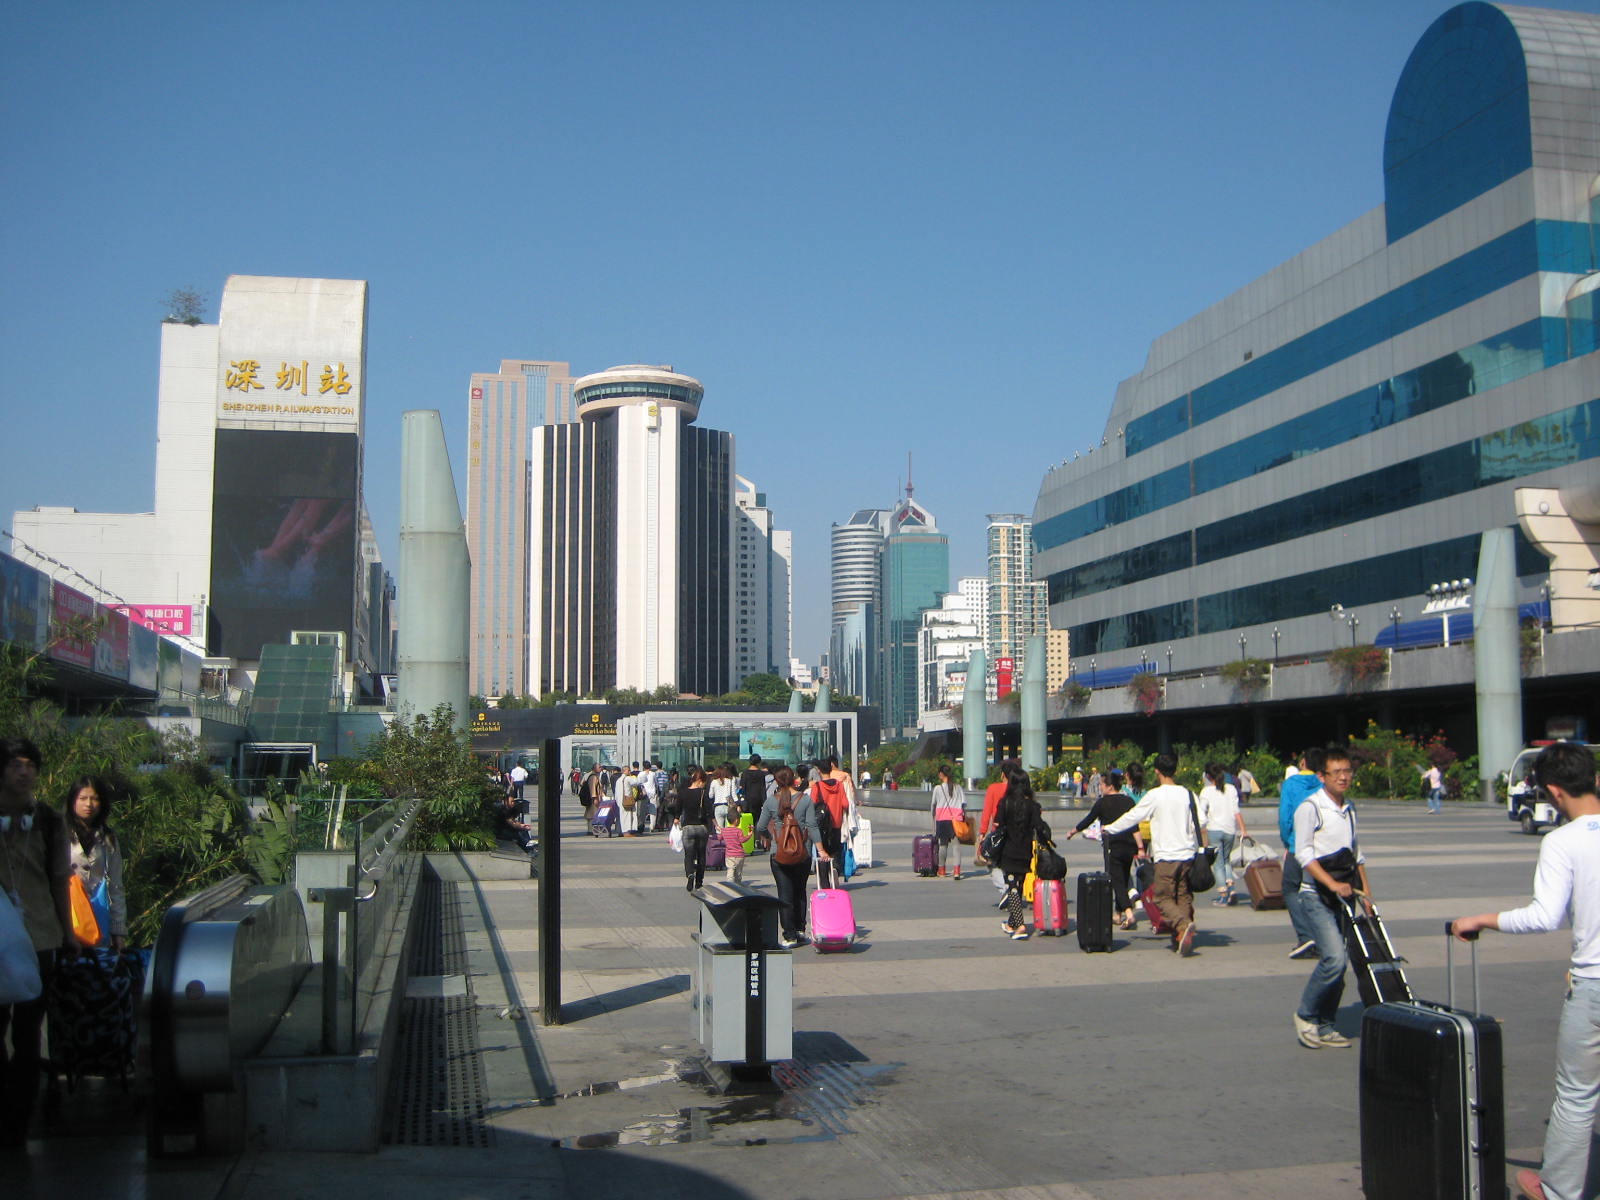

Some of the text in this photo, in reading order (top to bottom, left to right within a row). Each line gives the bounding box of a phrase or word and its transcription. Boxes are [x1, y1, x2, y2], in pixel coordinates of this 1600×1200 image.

[225, 360, 352, 396] 深圳站
[223, 402, 273, 413] SHENZHEN
